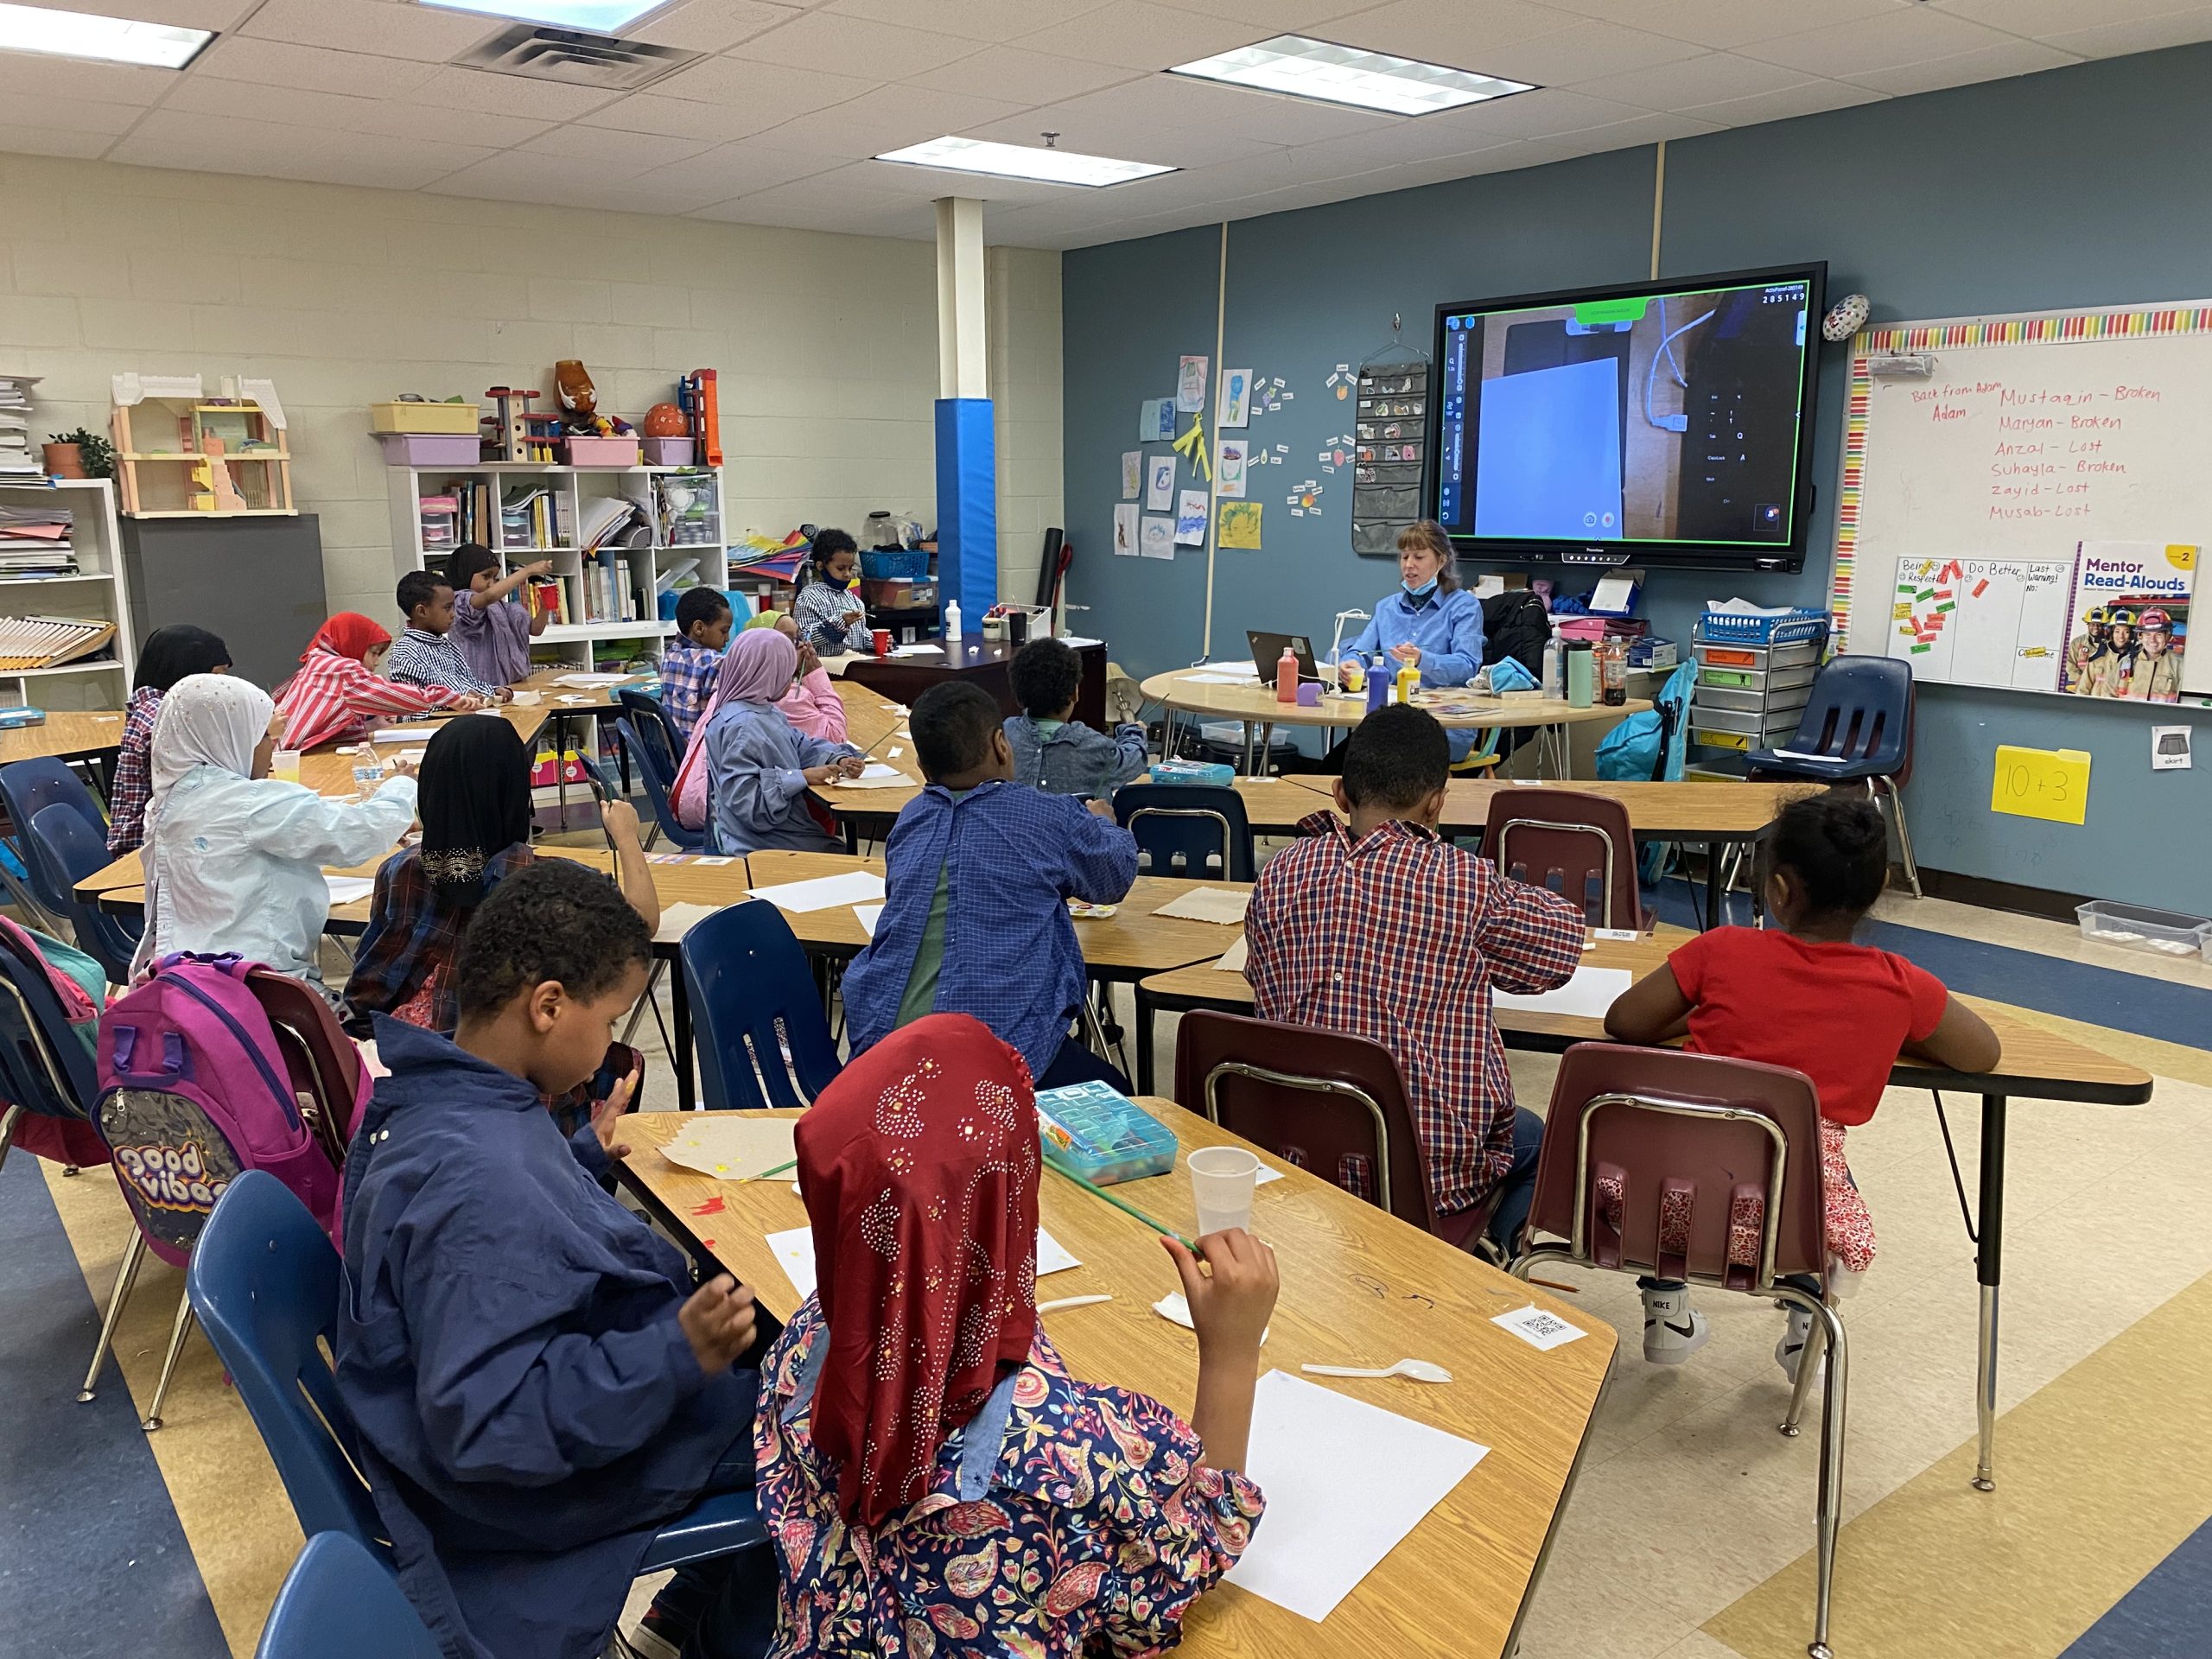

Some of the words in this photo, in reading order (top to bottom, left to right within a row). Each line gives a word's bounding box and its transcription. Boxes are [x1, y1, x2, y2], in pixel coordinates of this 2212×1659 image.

[1942, 384, 1972, 397] from
[1976, 382, 2002, 394] Adam
[2114, 385, 2161, 403] Broken
[1932, 404, 1966, 422] Adam
[1999, 416, 2053, 433] Maryan
[2071, 415, 2122, 430] Broken
[1994, 442, 2044, 457] Anzal
[2069, 440, 2102, 454] Lost
[1991, 462, 2056, 477] Suhayla
[2076, 461, 2127, 474] Broken
[2056, 482, 2089, 495] Lost
[2056, 504, 2092, 517] Lost
[2181, 552, 2190, 562] 2
[1969, 563, 1984, 574] Do
[1989, 563, 2022, 576] Better
[2030, 564, 2050, 573] Last
[2086, 558, 2144, 573] Mentor
[2027, 574, 2058, 584] Warning!
[2084, 573, 2185, 591] Read-Alouds
[2005, 765, 2030, 797] 10
[2037, 779, 2046, 792] +
[2053, 770, 2068, 802] 3
[120, 1145, 200, 1175] good
[1652, 1300, 1670, 1310] NIKE
